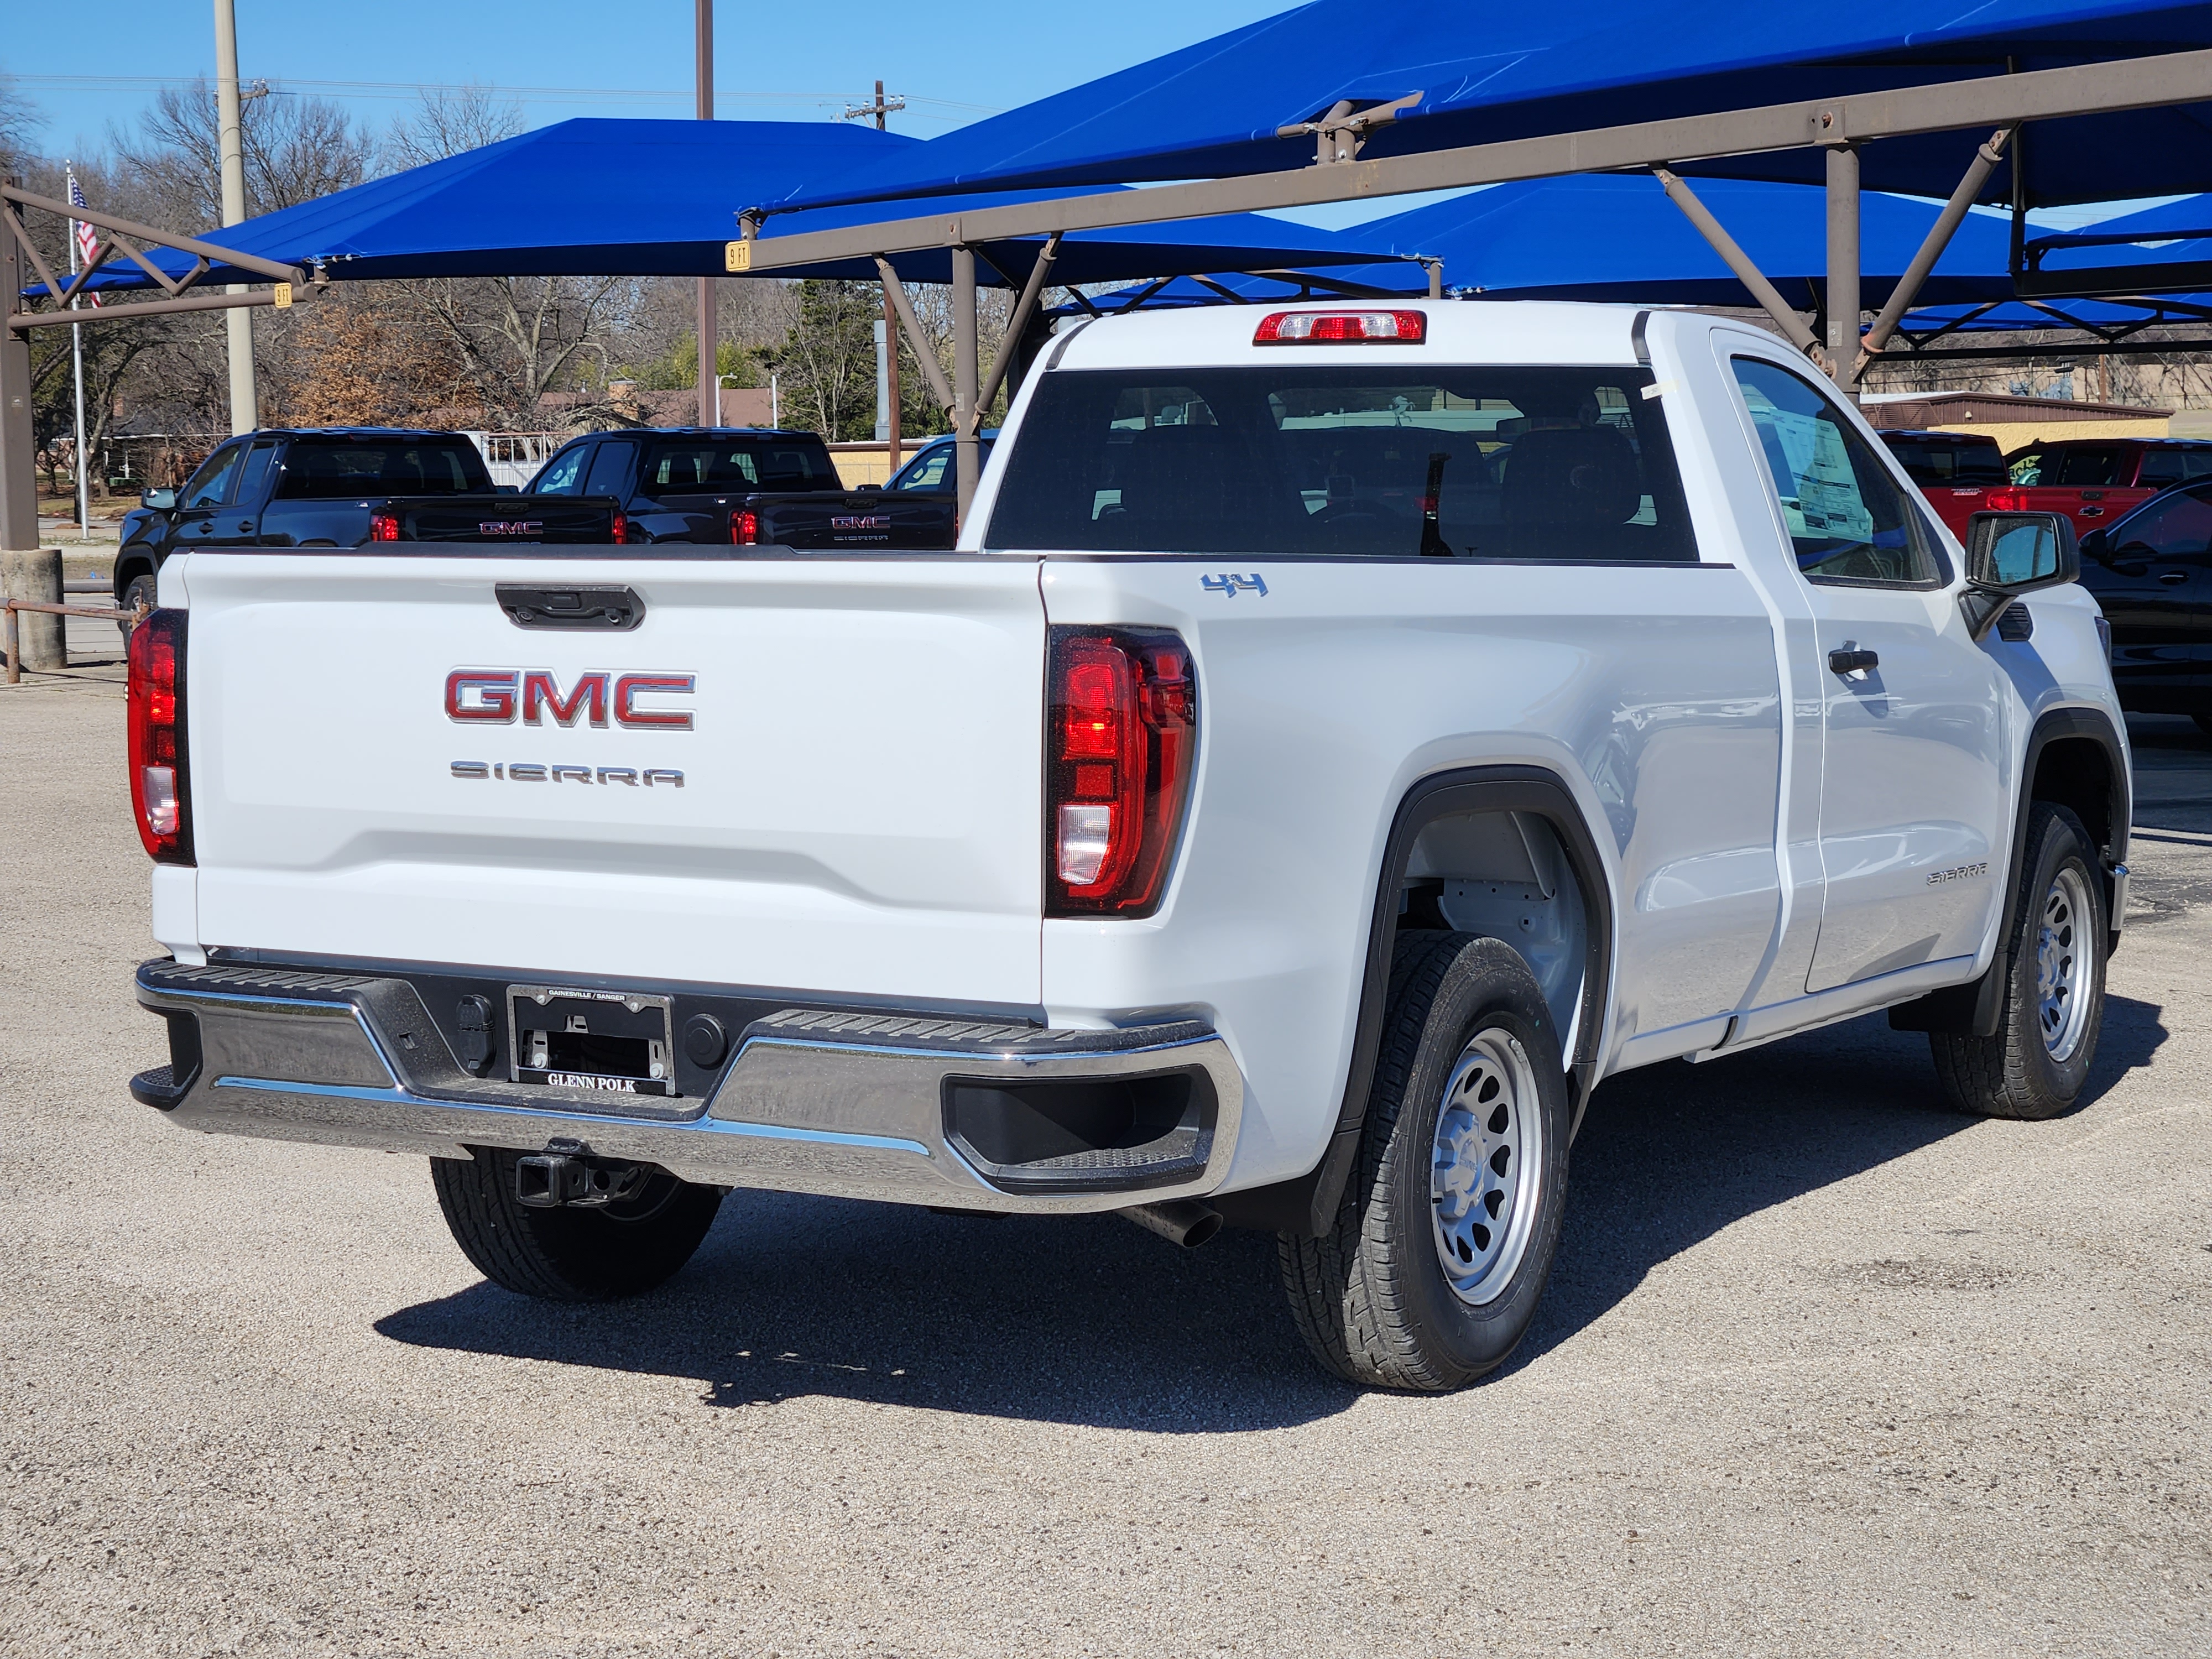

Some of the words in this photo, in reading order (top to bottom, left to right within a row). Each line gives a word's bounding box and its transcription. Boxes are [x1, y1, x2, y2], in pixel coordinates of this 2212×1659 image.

[731, 248, 734, 264] 9
[277, 289, 280, 302] 9
[479, 521, 543, 535] GMC
[831, 516, 890, 529] GMC
[445, 666, 698, 731] GMC
[450, 760, 685, 788] SIERRA
[1927, 862, 1988, 886] SIERRA
[549, 990, 592, 999] GAINESVILLE
[548, 1073, 596, 1088] GLENN
[597, 1078, 636, 1093] POLK
